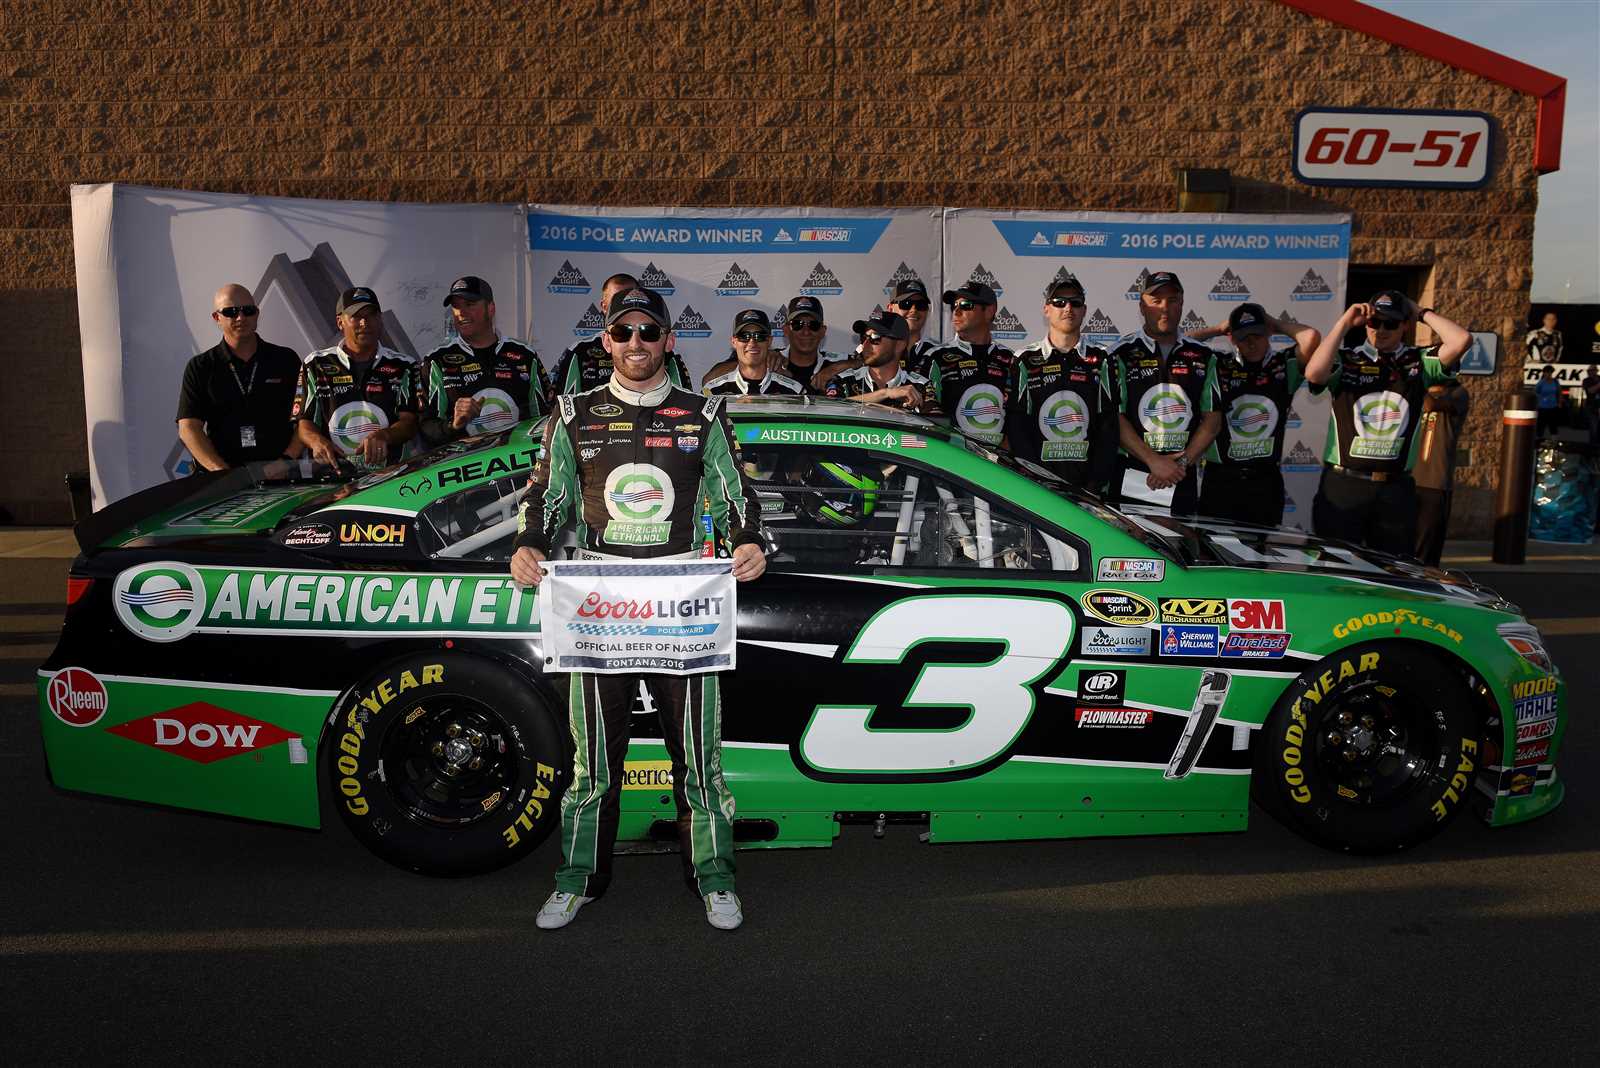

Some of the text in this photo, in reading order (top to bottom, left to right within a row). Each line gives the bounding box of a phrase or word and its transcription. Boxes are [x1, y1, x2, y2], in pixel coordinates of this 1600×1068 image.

[1304, 127, 1482, 168] 60-51
[541, 226, 763, 243] 2016 POLE AWARD WINNER
[815, 230, 850, 241] NASCAR
[1071, 234, 1106, 246] NASCAR
[1120, 234, 1340, 249] 2016 POLE AWARD WINNER
[723, 270, 751, 281] Coors
[808, 270, 835, 281] Coors
[437, 447, 541, 489] REALT
[340, 522, 406, 543] UNOH
[610, 523, 666, 534] AMERICAN
[612, 532, 662, 542] ETHANOL
[1124, 561, 1152, 571] NASCAR
[208, 573, 463, 623] AMERICAN
[577, 591, 725, 619] Coors LIGHT
[1103, 596, 1128, 604] NASCAR
[1107, 604, 1133, 614] Sprint
[1231, 601, 1284, 630] 3M
[1162, 614, 1227, 624] MECHANIX WEAR
[1333, 608, 1463, 644] GOODYEAR
[1092, 633, 1147, 645] Coors LIGHT
[1181, 632, 1214, 641] SHERWIN
[1229, 635, 1284, 649] Duralast
[574, 641, 716, 653] OFFICIAL BEER OF NASCAR
[606, 659, 685, 669] FONTANA 2016
[801, 595, 1075, 773] 3
[1089, 675, 1113, 689] IR
[1513, 676, 1557, 699] MOOG
[54, 671, 104, 717] Rheem
[1077, 710, 1148, 729] FLOWMASTER
[1283, 652, 1380, 804] GOODYEAR
[338, 664, 444, 816] GOODYEAR
[1431, 737, 1478, 822] EAGLE
[502, 761, 555, 849] EAGLE
